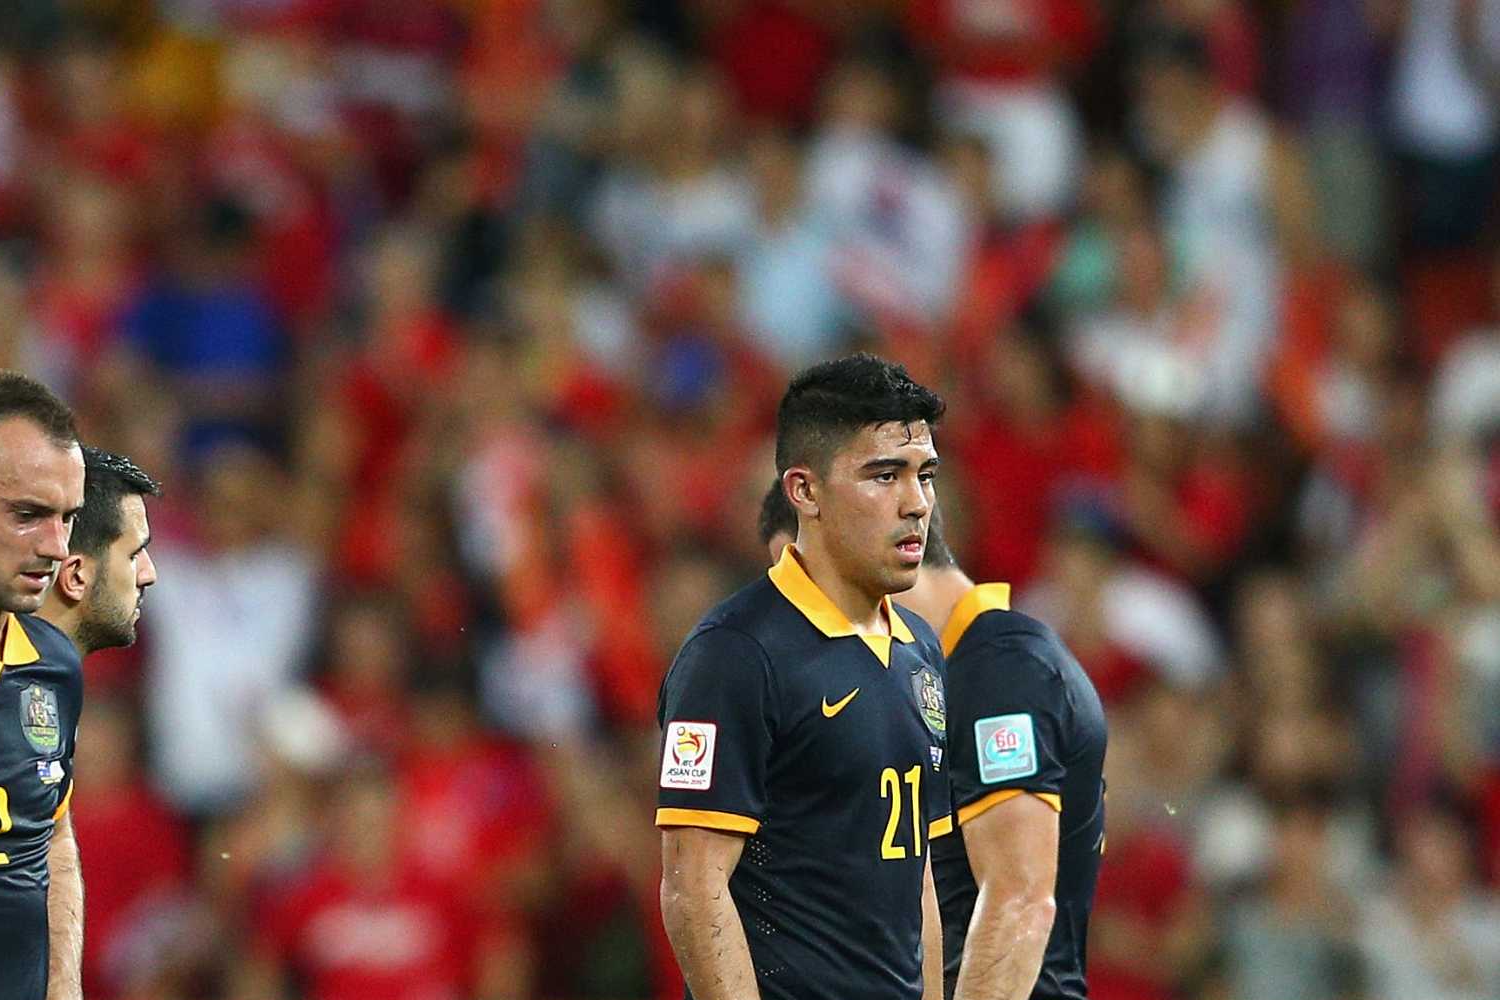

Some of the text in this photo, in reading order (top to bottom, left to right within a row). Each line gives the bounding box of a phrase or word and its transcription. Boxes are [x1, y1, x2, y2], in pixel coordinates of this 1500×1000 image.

[667, 768, 707, 777] ASIAN CUP
[880, 765, 922, 860] 21
